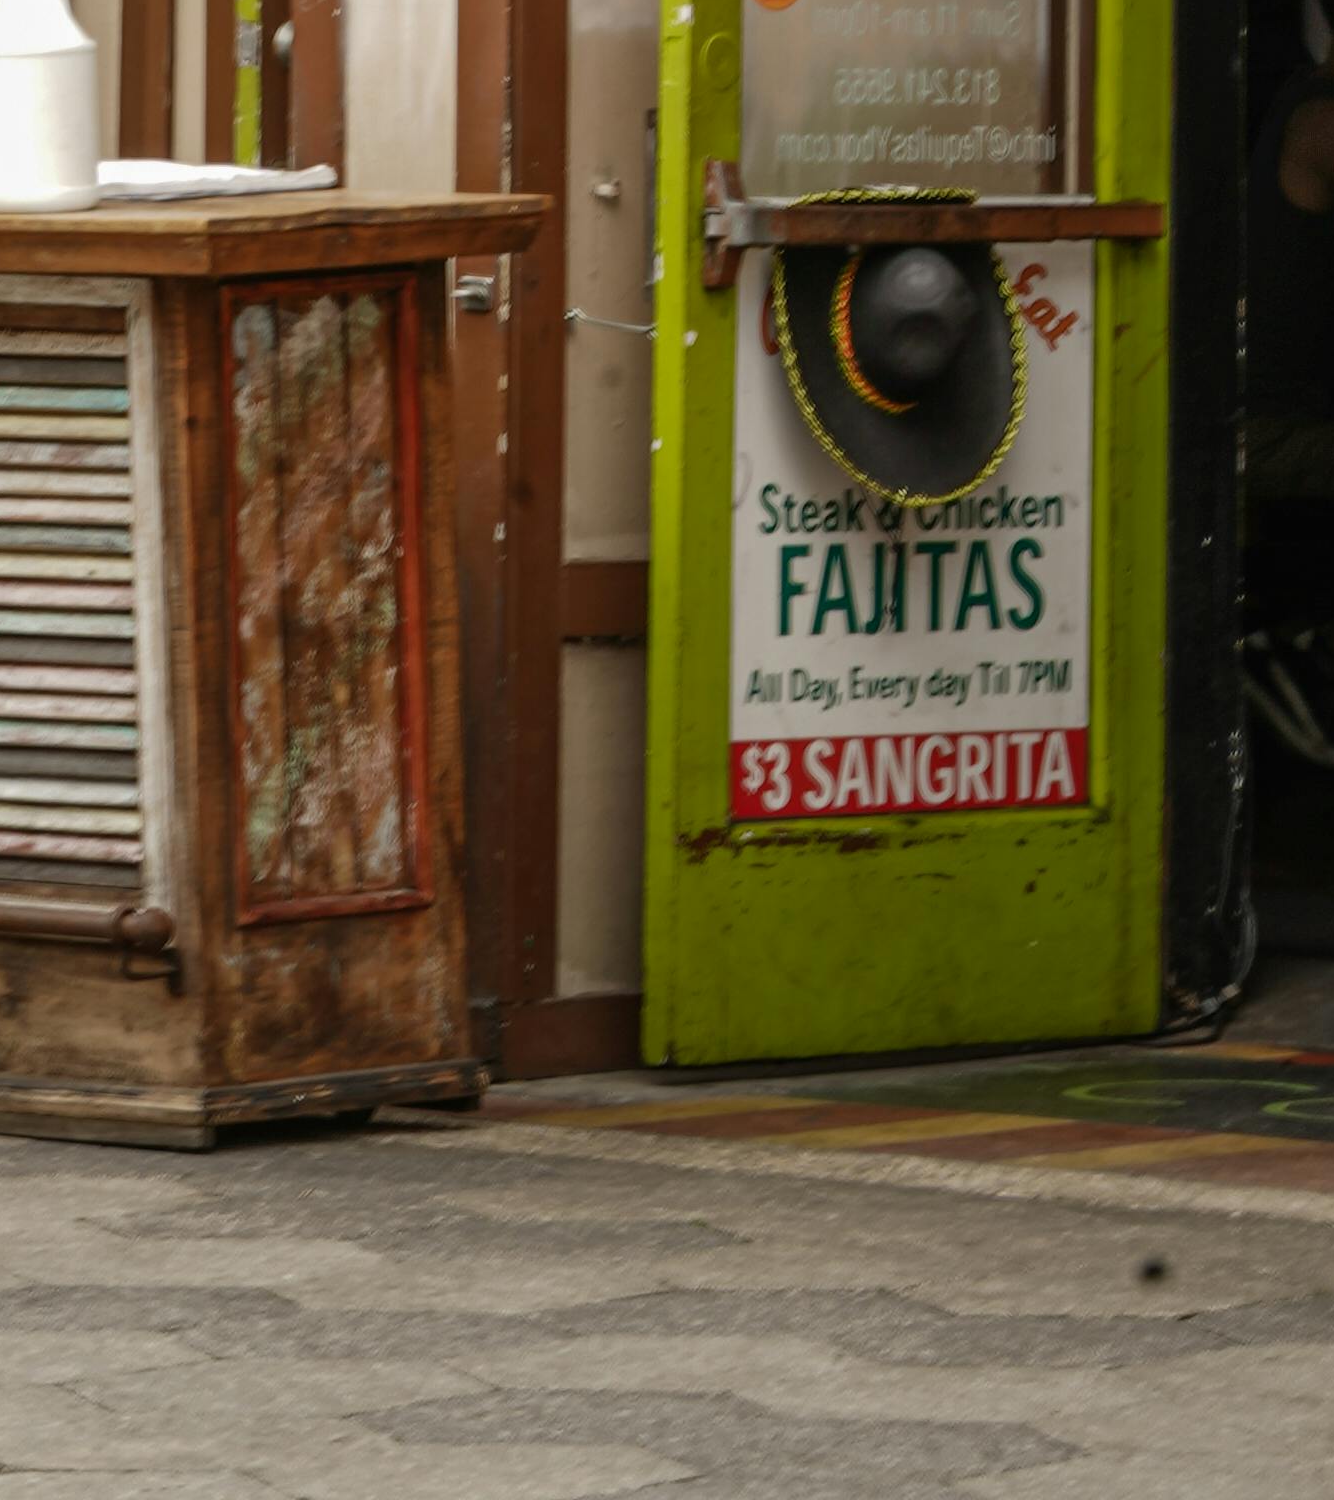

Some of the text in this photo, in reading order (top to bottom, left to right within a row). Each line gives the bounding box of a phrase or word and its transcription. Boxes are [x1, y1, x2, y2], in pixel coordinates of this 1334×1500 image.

[759, 482, 866, 534] Steak
[777, 536, 1046, 637] FAJITAS
[848, 664, 919, 709] Every
[924, 664, 971, 708] day
[1015, 657, 1073, 695] 7PM
[740, 729, 1077, 812] $3 SANGRITA
